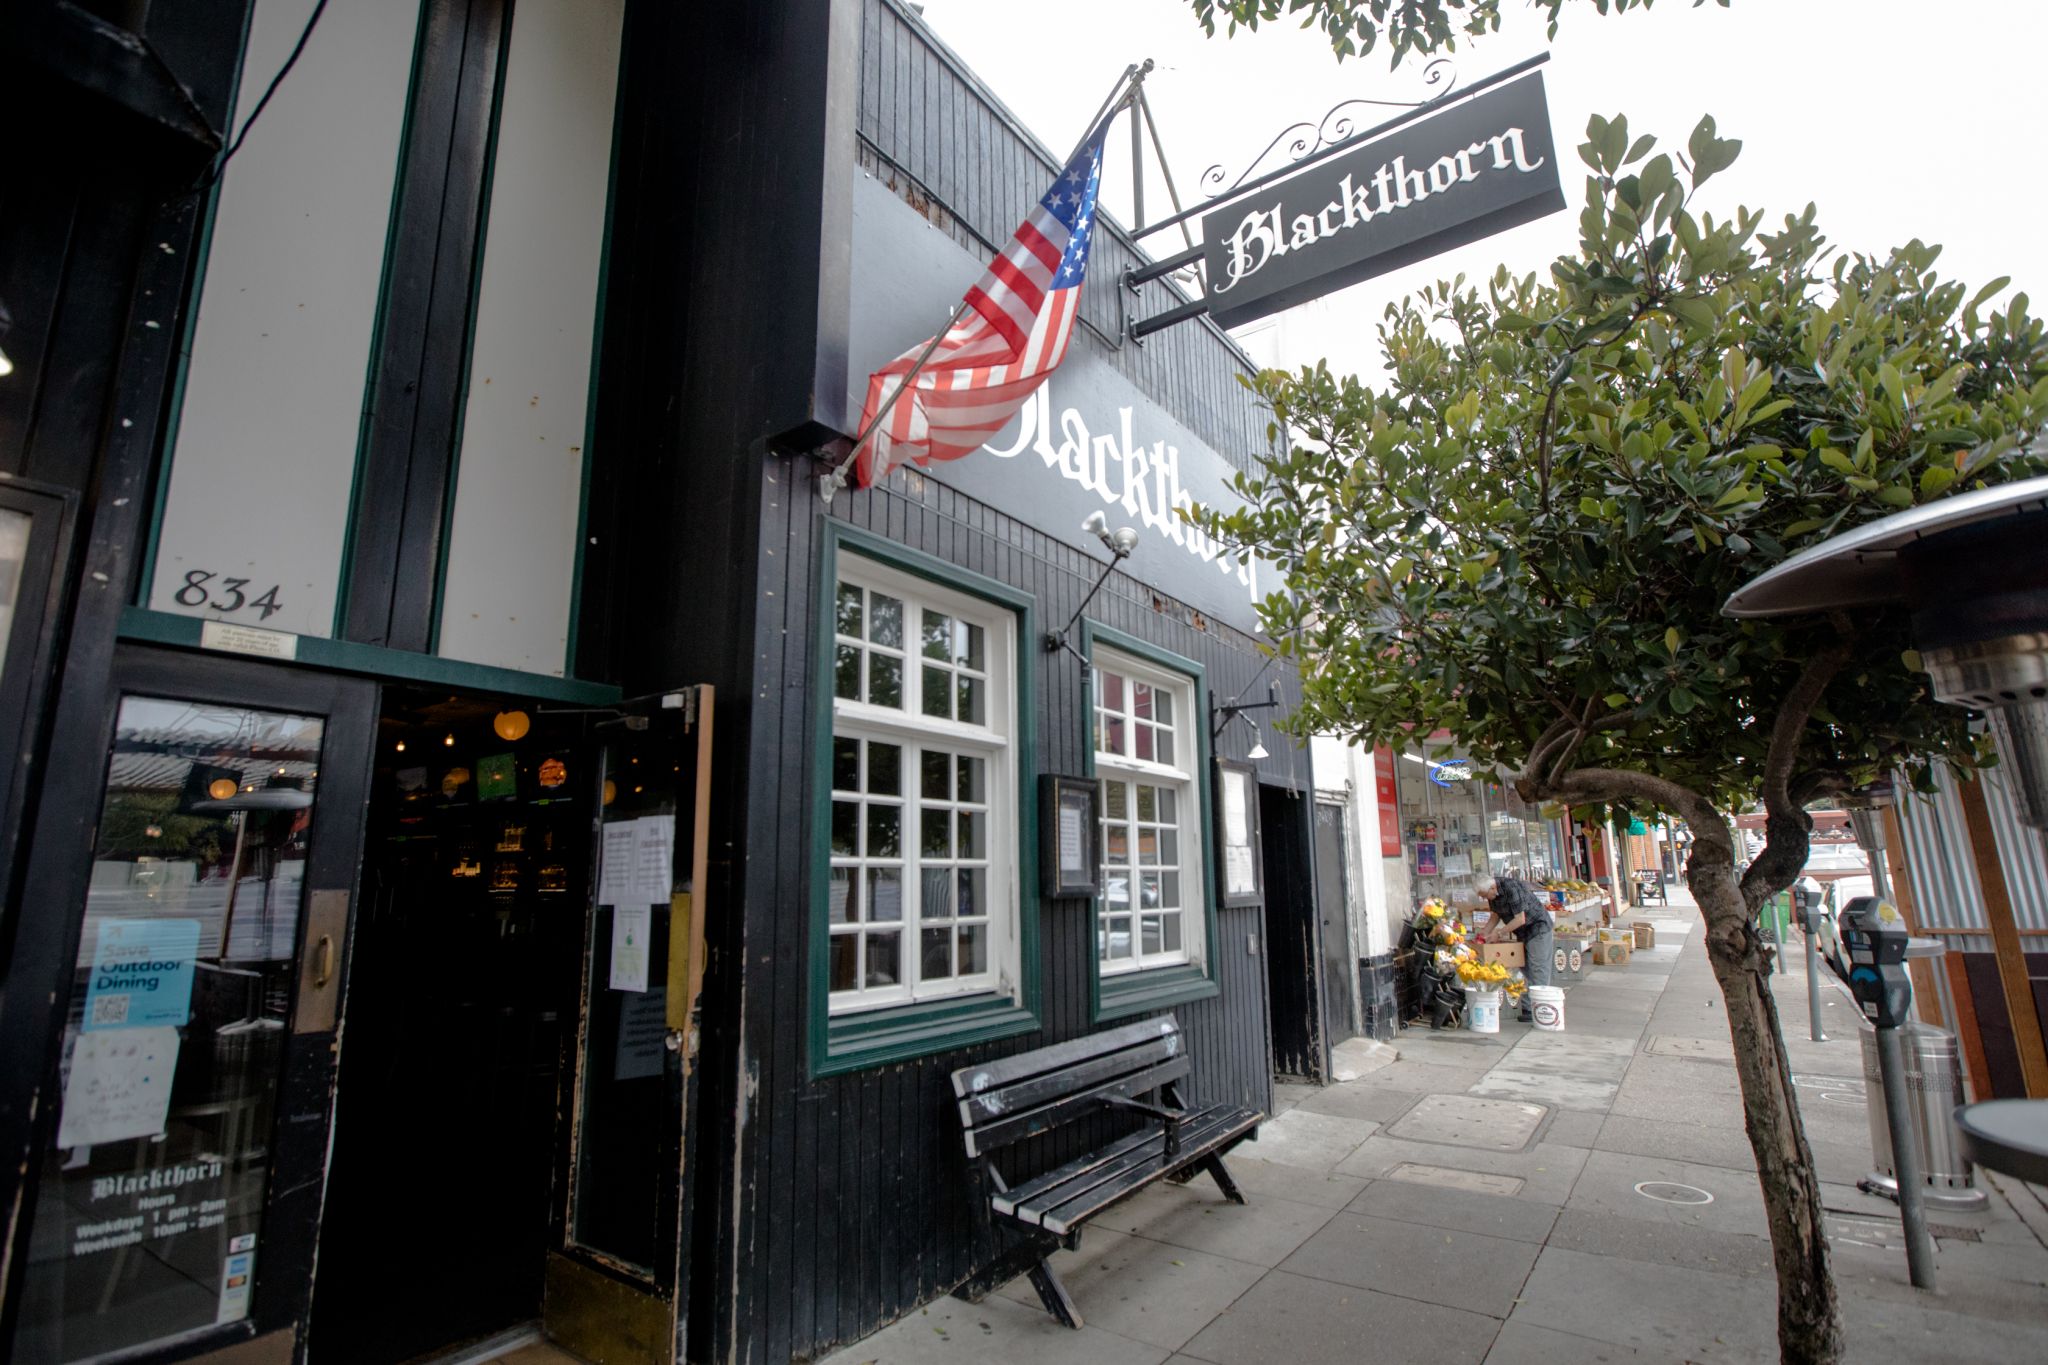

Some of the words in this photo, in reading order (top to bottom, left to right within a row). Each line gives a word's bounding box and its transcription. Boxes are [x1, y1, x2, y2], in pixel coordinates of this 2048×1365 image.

[1214, 127, 1545, 293] Blackthorn
[174, 570, 283, 621] 834
[104, 944, 150, 957] Save
[101, 959, 182, 974] Outdoor
[96, 975, 160, 991] Dining
[91, 1163, 222, 1202] Blackthorn
[138, 1194, 176, 1210] Hours
[76, 1215, 144, 1239] Weekdays
[74, 1231, 143, 1256] Weekends
